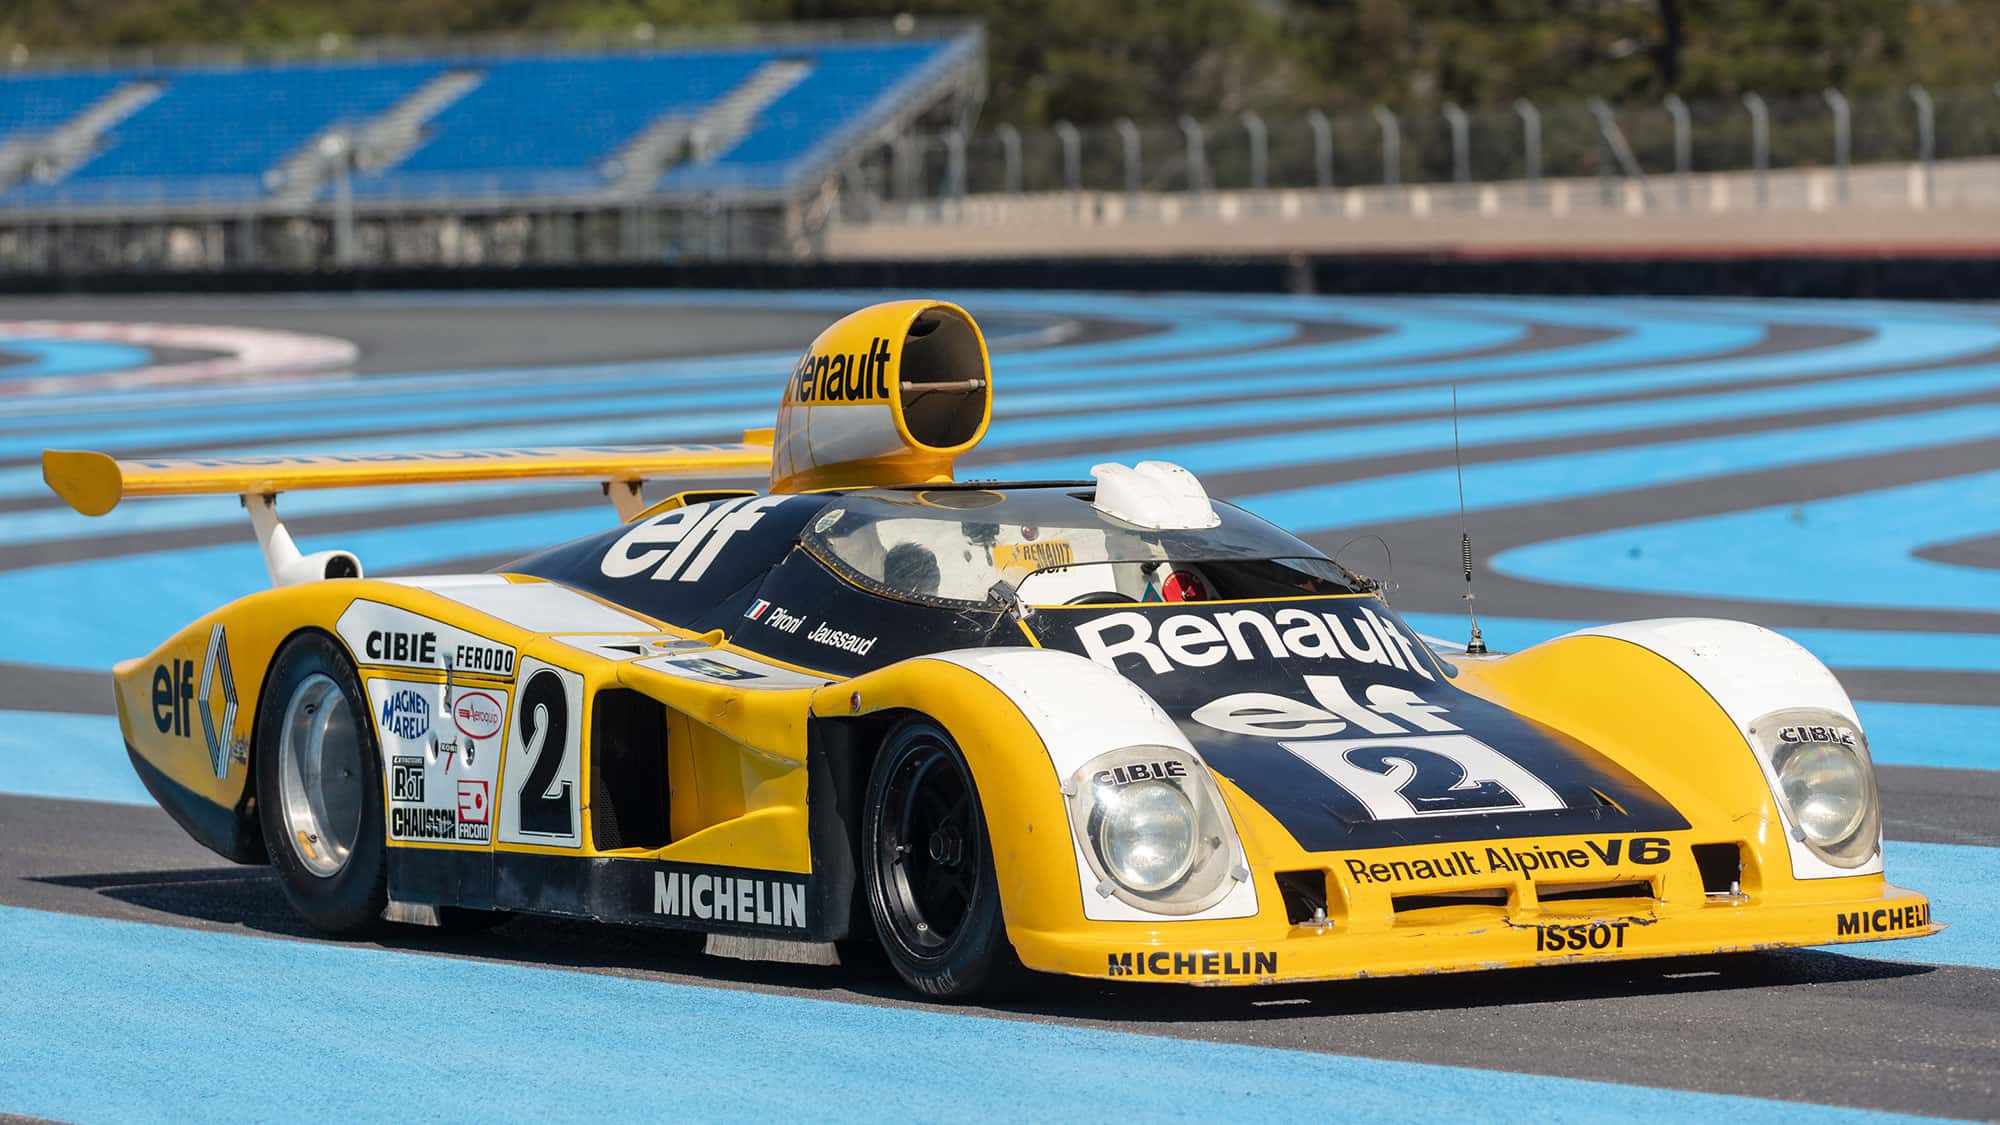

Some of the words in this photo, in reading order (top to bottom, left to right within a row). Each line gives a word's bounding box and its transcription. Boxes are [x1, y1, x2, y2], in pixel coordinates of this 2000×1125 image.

[601, 495, 799, 582] elf
[456, 645, 513, 672] FERODO
[765, 607, 807, 633] Pironi
[808, 622, 877, 656] Jaussaud
[1074, 605, 1436, 682] Renault
[152, 659, 194, 737] elf
[1192, 675, 1465, 737] elf
[519, 668, 574, 838] 2
[1342, 745, 1526, 815] 2
[460, 823, 488, 839] FACOM
[1344, 851, 1480, 884] Renault
[1485, 845, 1590, 881] Alpine
[1584, 837, 1671, 866] V6
[653, 871, 806, 928] MICHELIN
[1108, 951, 1277, 976] MICHELIN
